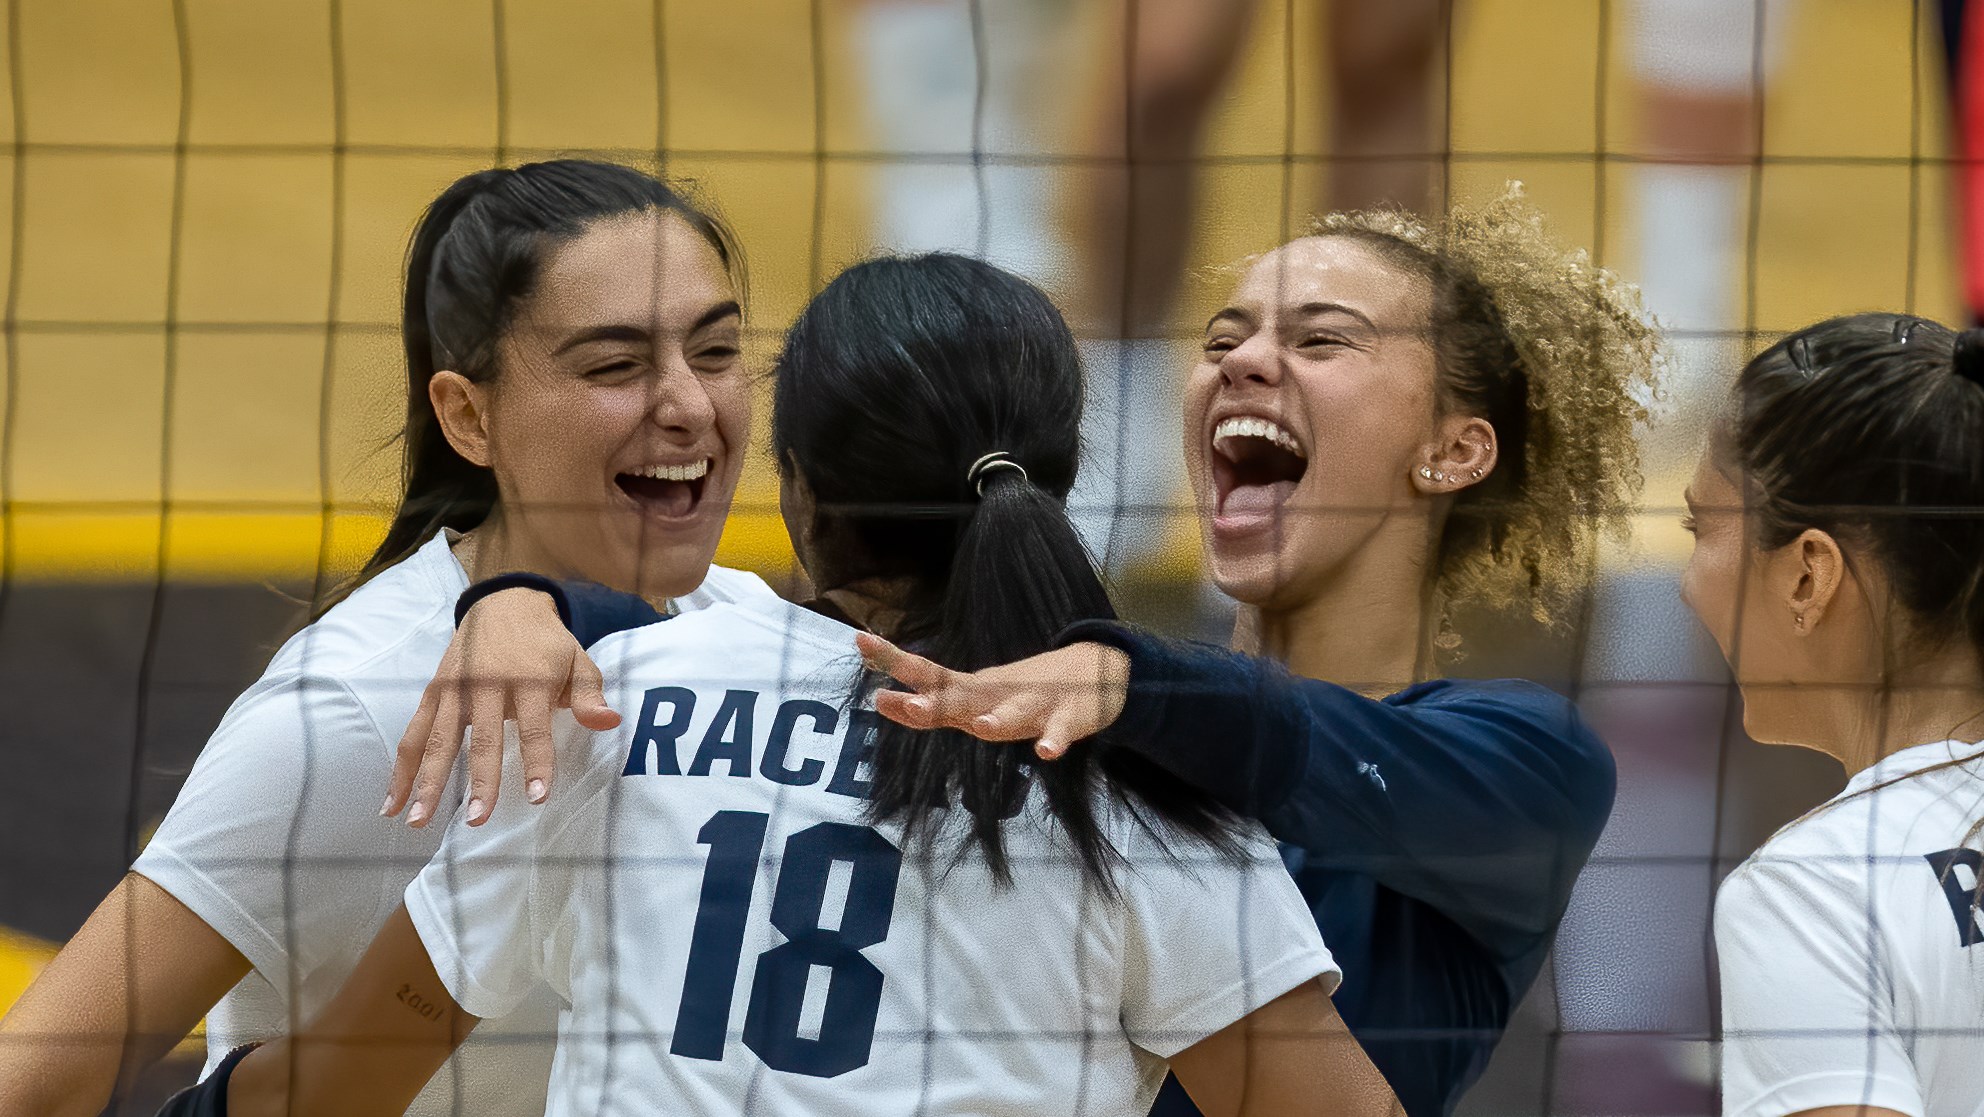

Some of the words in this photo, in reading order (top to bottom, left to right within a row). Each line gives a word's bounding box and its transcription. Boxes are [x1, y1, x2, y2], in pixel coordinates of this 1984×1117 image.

[622, 686, 1029, 820] RACE
[396, 983, 445, 1022] 2001
[669, 809, 902, 1079] 18
